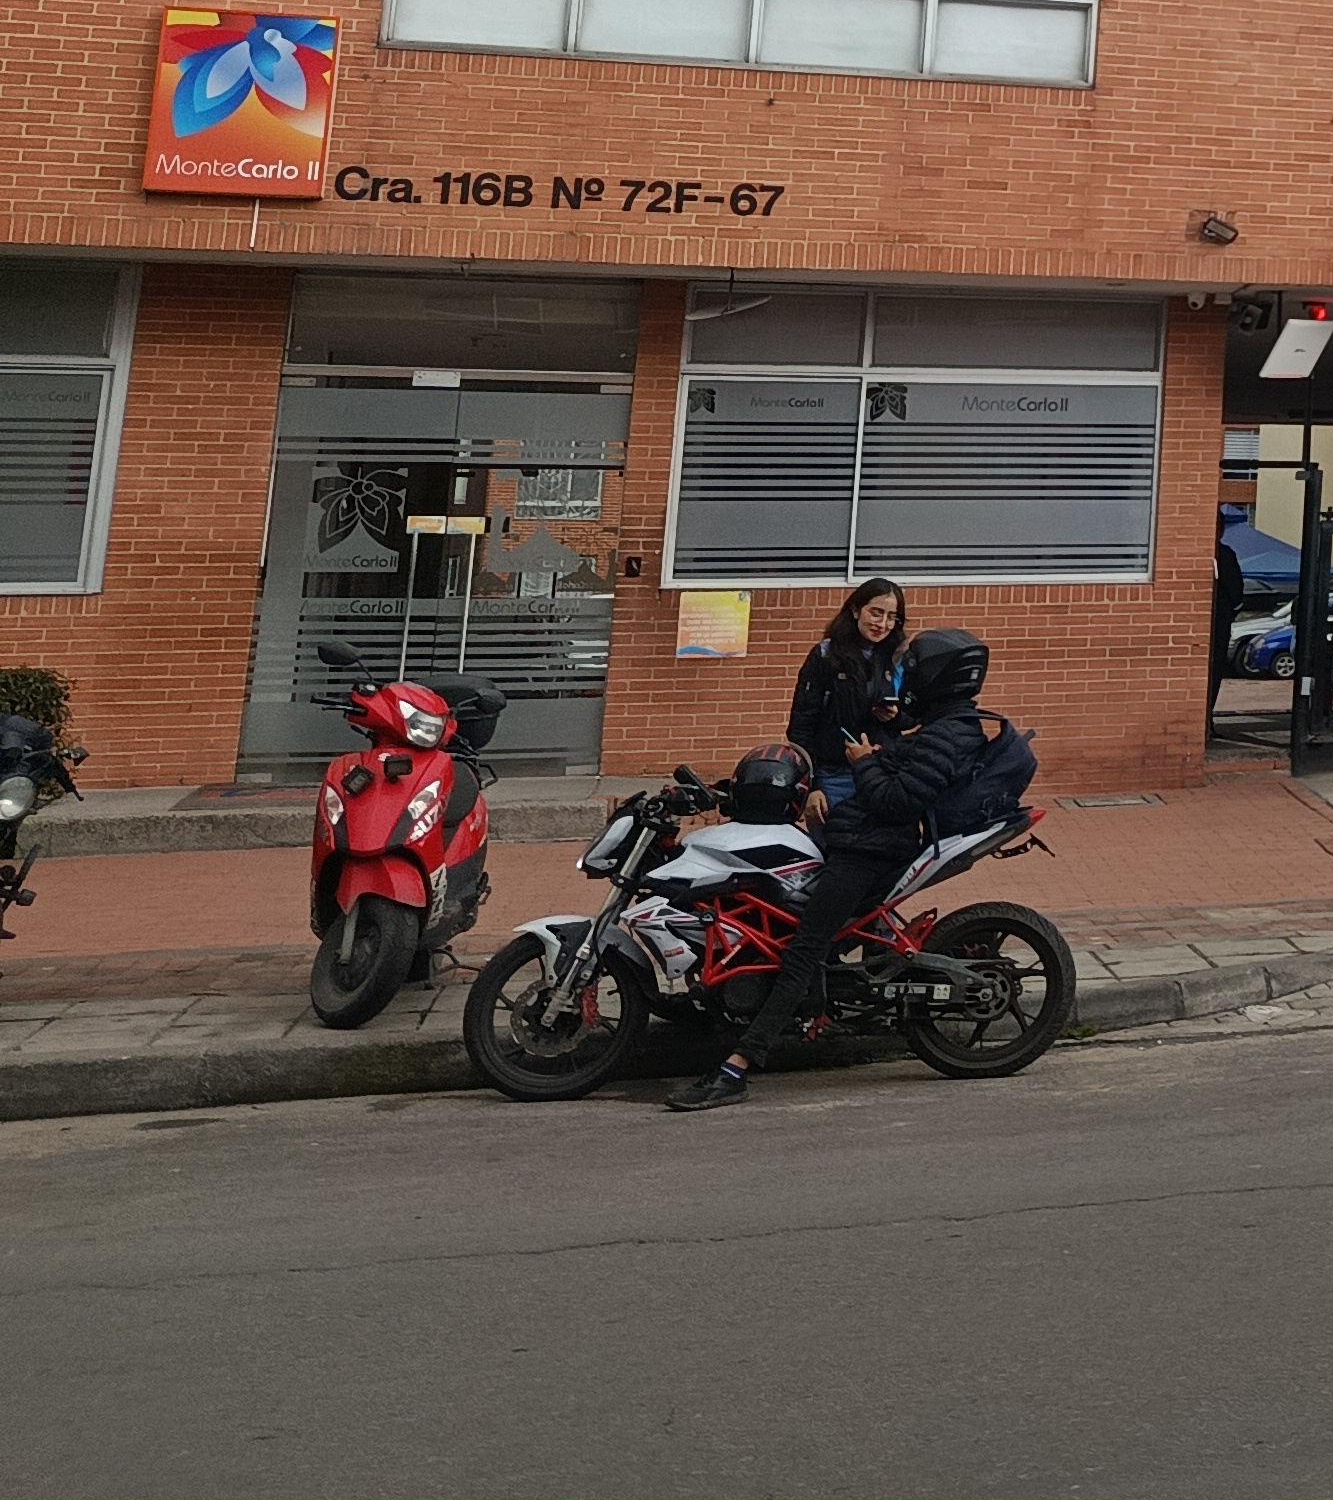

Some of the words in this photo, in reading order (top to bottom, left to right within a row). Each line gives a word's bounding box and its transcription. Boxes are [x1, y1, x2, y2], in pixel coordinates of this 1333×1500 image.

[155, 153, 298, 180] MonteCarlo
[334, 166, 422, 204] Cra.
[433, 172, 534, 208] 116B
[620, 180, 786, 217] 72F-67
